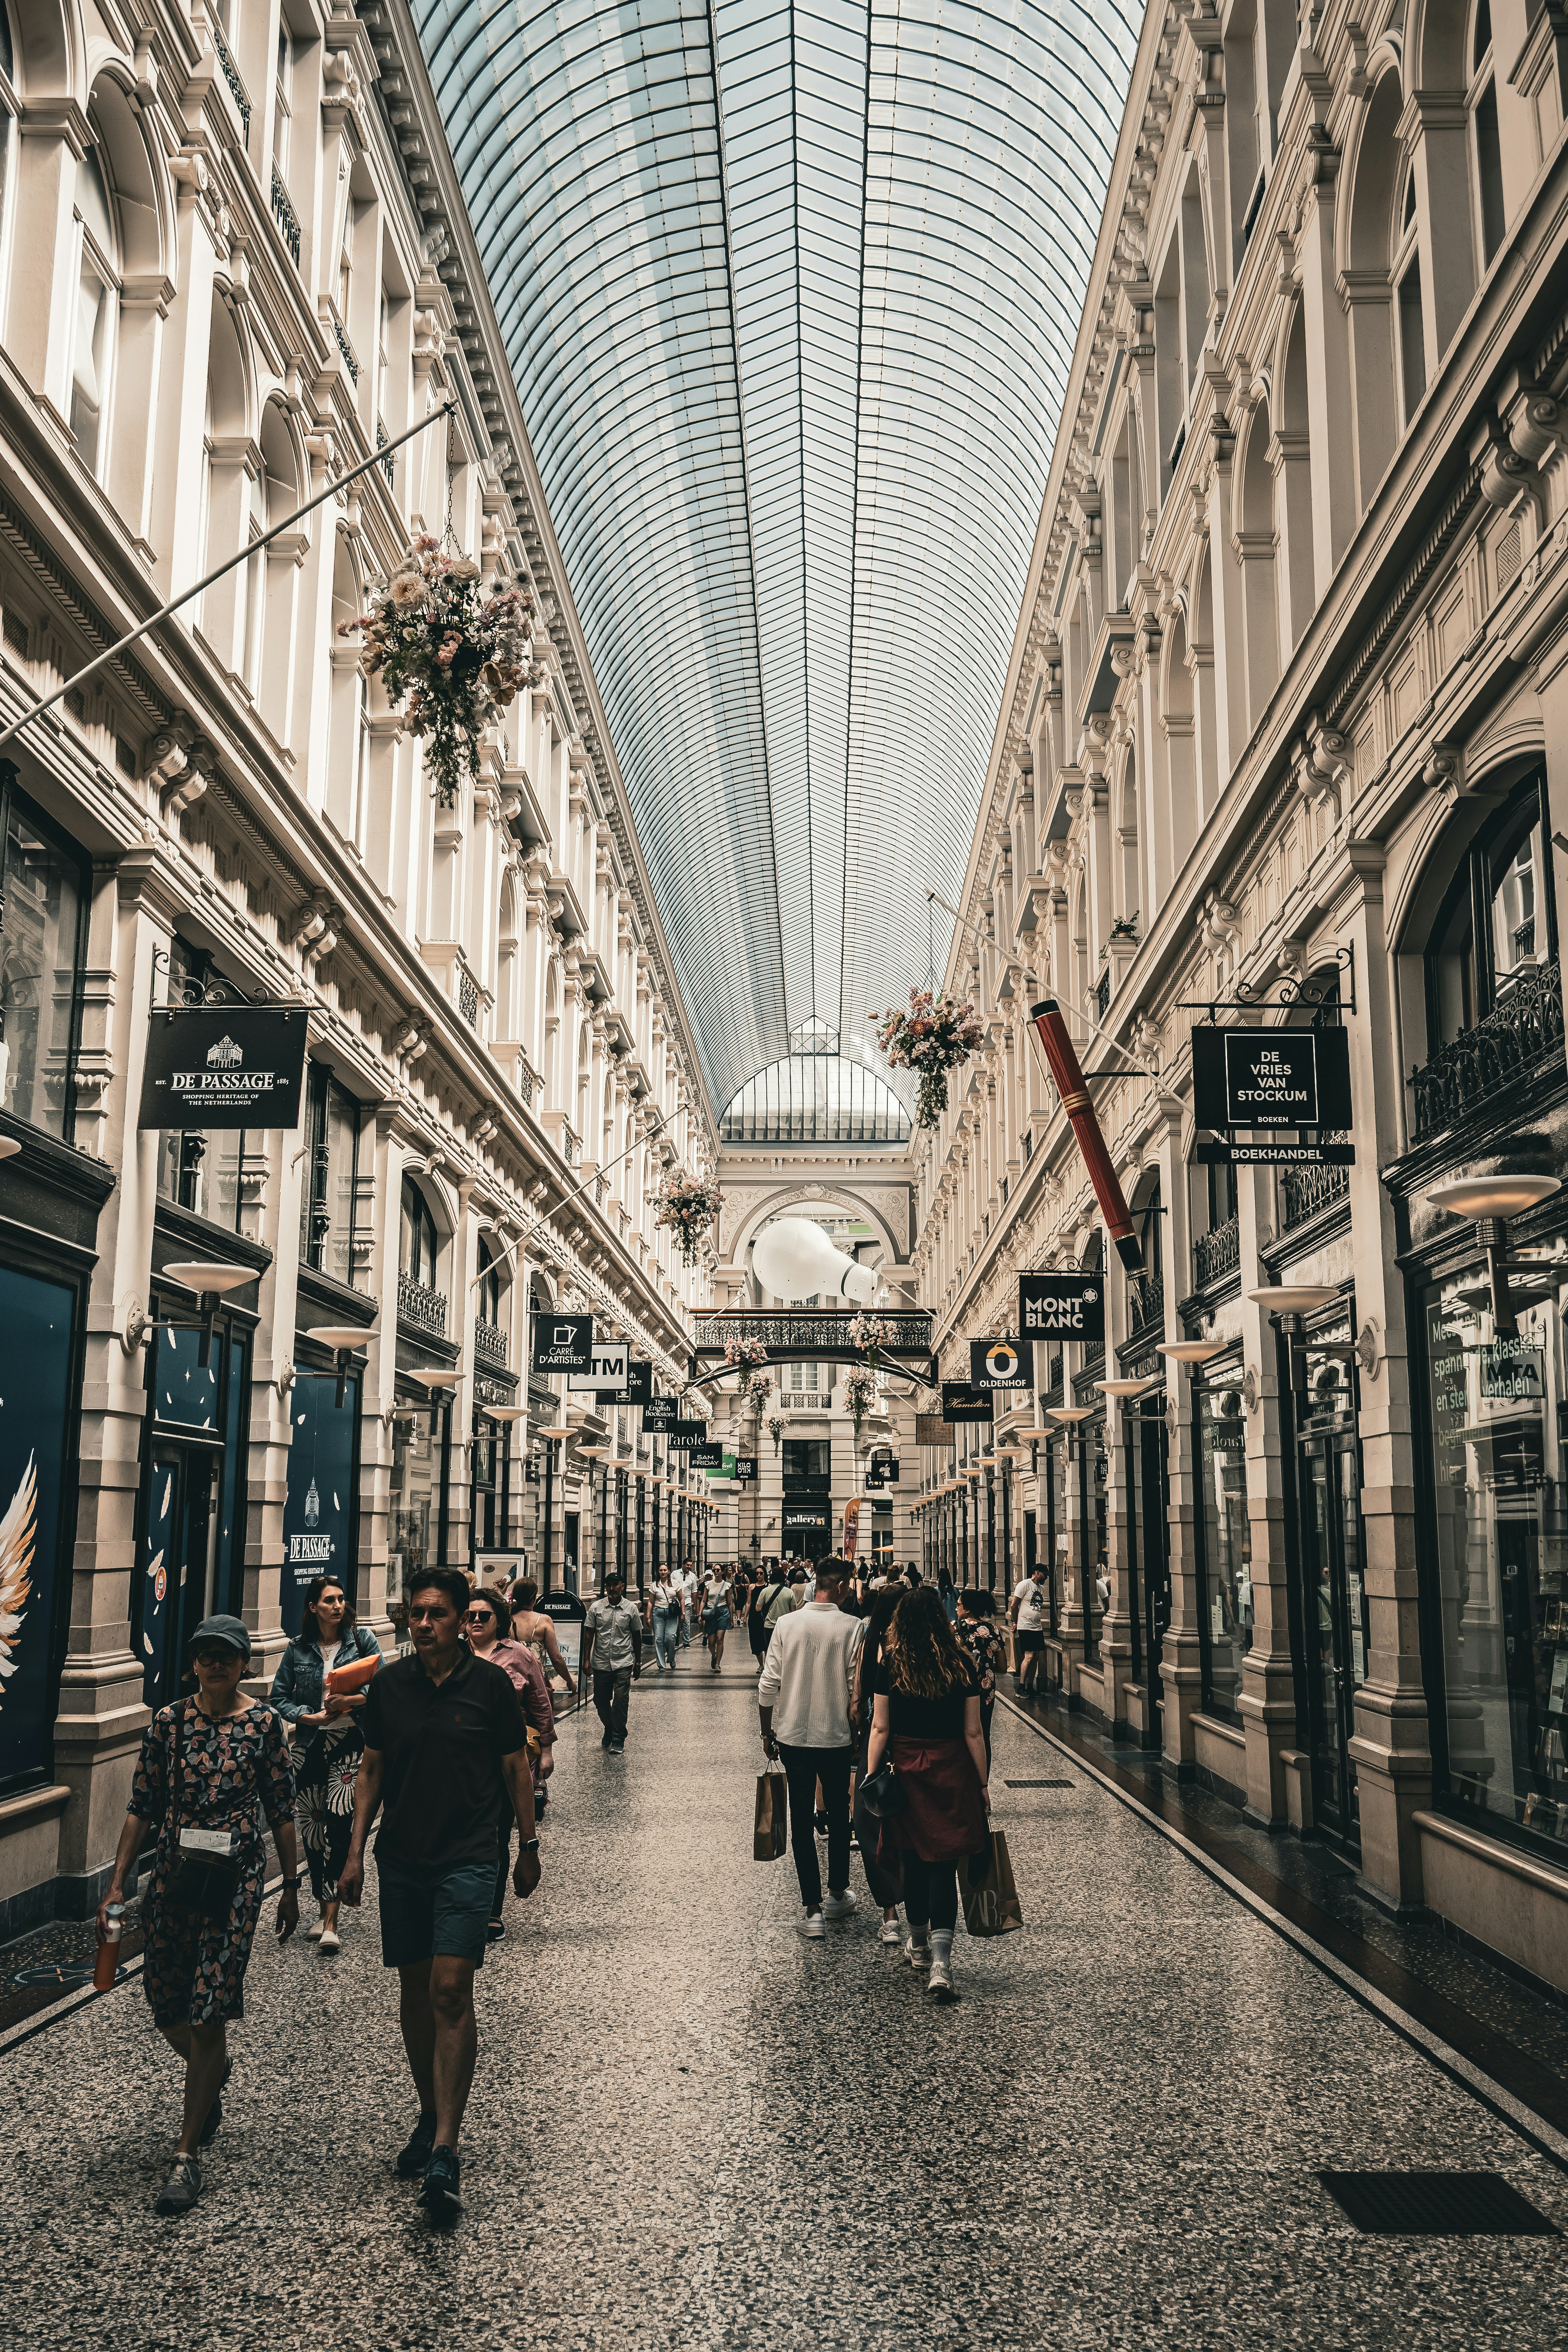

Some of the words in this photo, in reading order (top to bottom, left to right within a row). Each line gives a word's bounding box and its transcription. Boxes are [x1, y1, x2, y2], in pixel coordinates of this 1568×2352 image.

[1261, 1052, 1279, 1062] DE
[1250, 1064, 1291, 1075] VRIES
[171, 1075, 195, 1088] DE
[200, 1074, 274, 1088] PASSAGE
[1257, 1077, 1286, 1088] VAN
[1238, 1090, 1307, 1101] STOCKUM
[1231, 1149, 1323, 1159] BOEKHANDEL
[1026, 1298, 1082, 1312] MONT
[1026, 1313, 1082, 1328] BLANC
[549, 1346, 574, 1355] CARRÉ
[573, 1358, 623, 1375] TM
[946, 1397, 991, 1407] Hamilton
[669, 1433, 704, 1445] Parole
[290, 1538, 300, 1558] DE
[302, 1538, 330, 1558] PASSAGE
